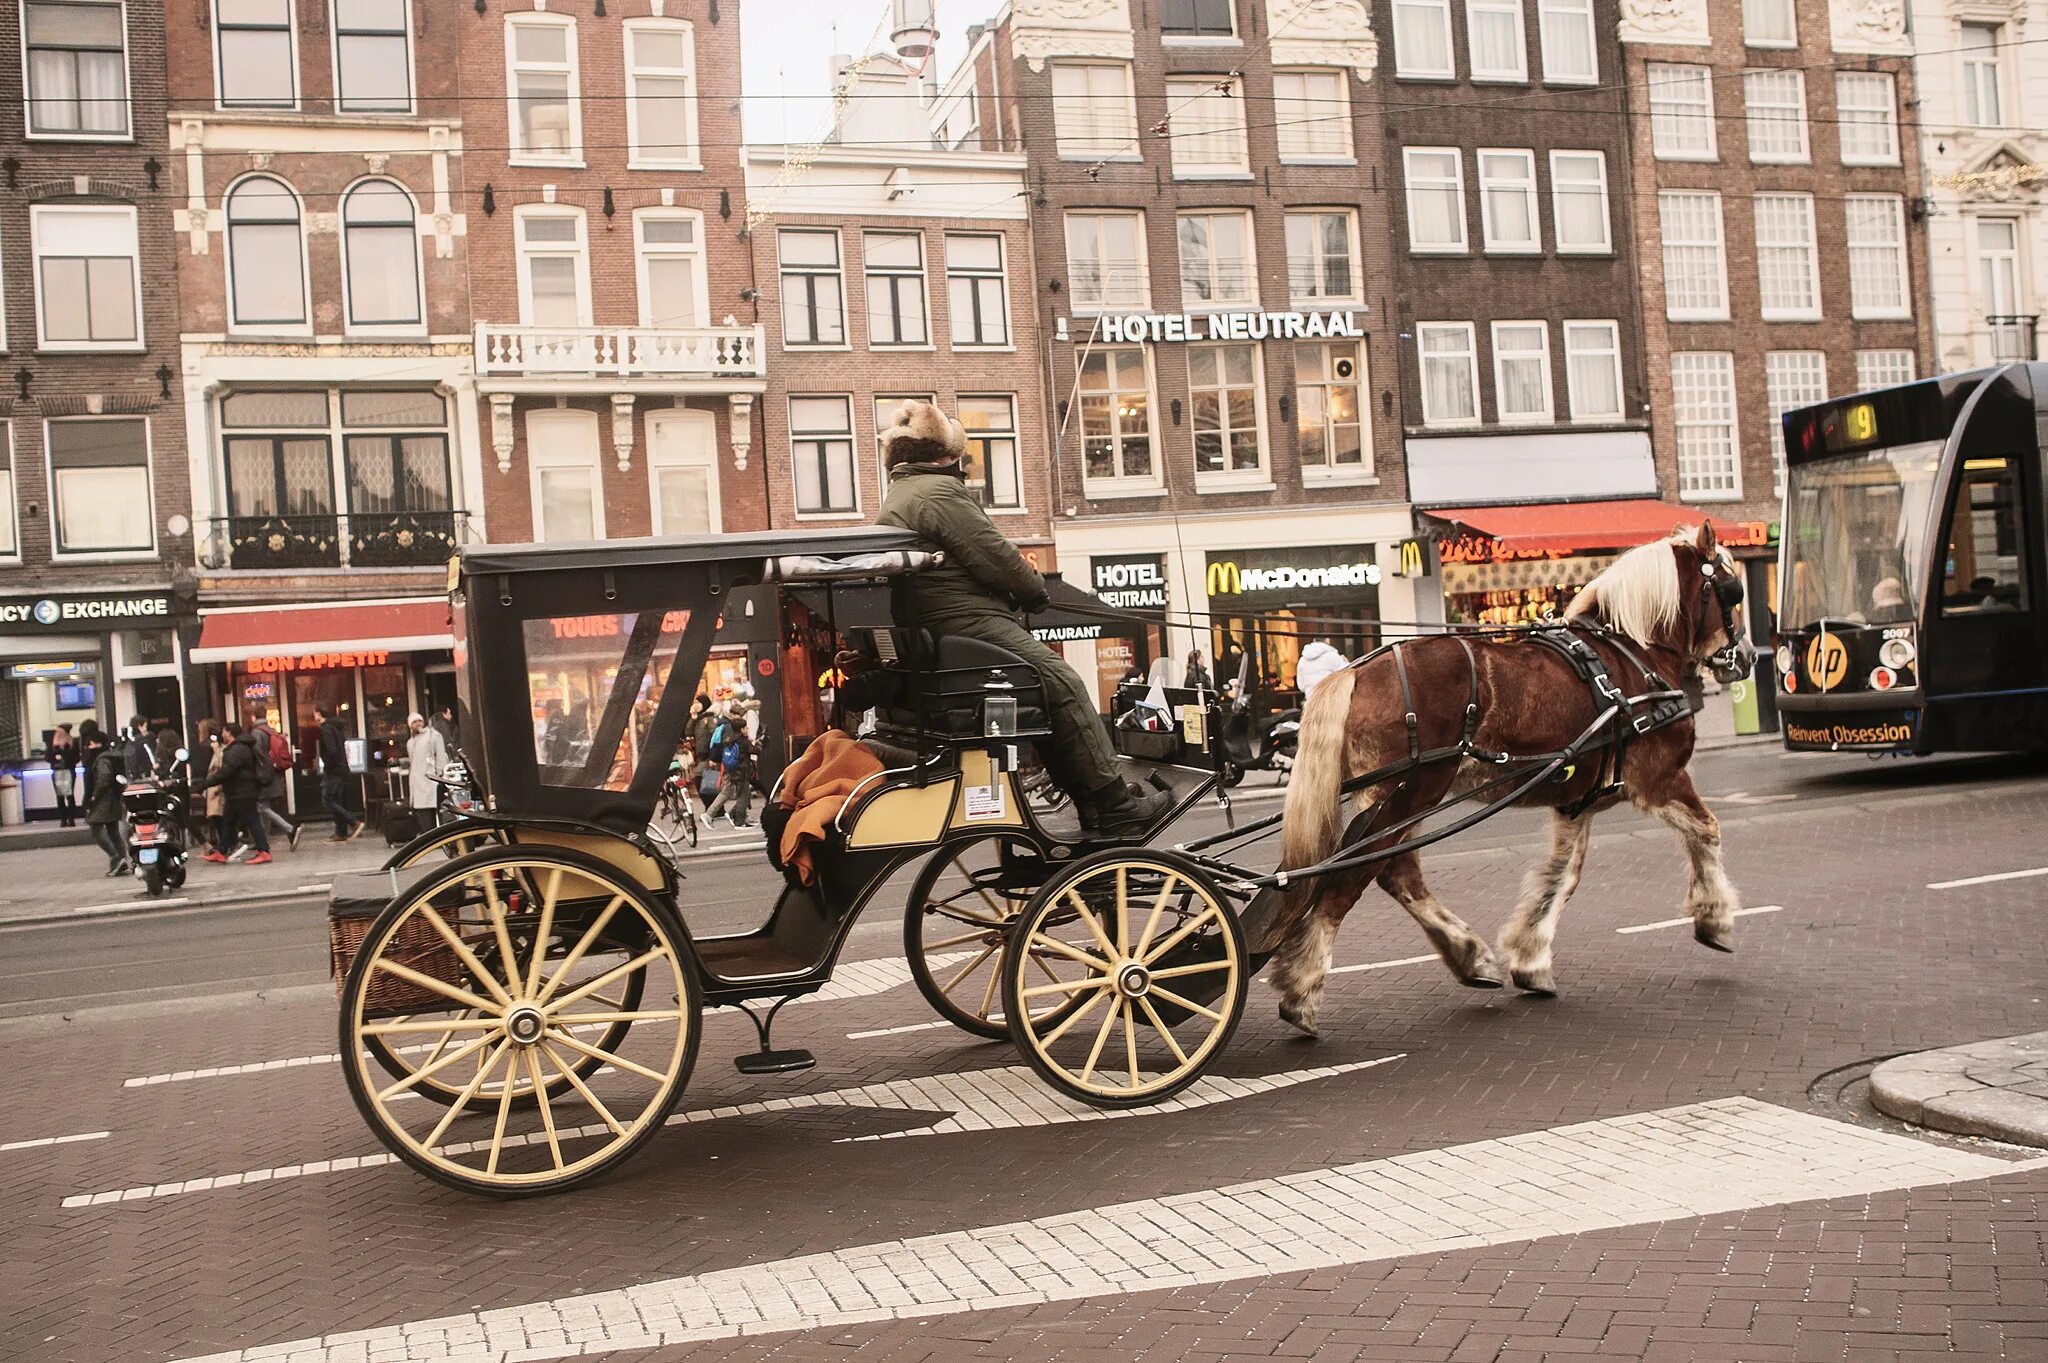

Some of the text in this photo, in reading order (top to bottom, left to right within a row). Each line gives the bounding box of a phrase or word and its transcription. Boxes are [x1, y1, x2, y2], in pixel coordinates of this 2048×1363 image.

[1101, 311, 1365, 343] HOTEL NEUTRAAL
[1858, 404, 1871, 440] 9
[1096, 564, 1164, 588] HOTEL
[1240, 564, 1381, 591] McDonald's
[62, 599, 168, 619] EXCHANGE
[1098, 589, 1166, 608] NEUTRAAL
[552, 616, 618, 638] TOURS
[1030, 625, 1101, 642] STAURANT
[247, 650, 389, 673] BON APPETIT
[1097, 646, 1133, 658] HOTEL
[1787, 723, 1911, 744] Reinvent Obsession
